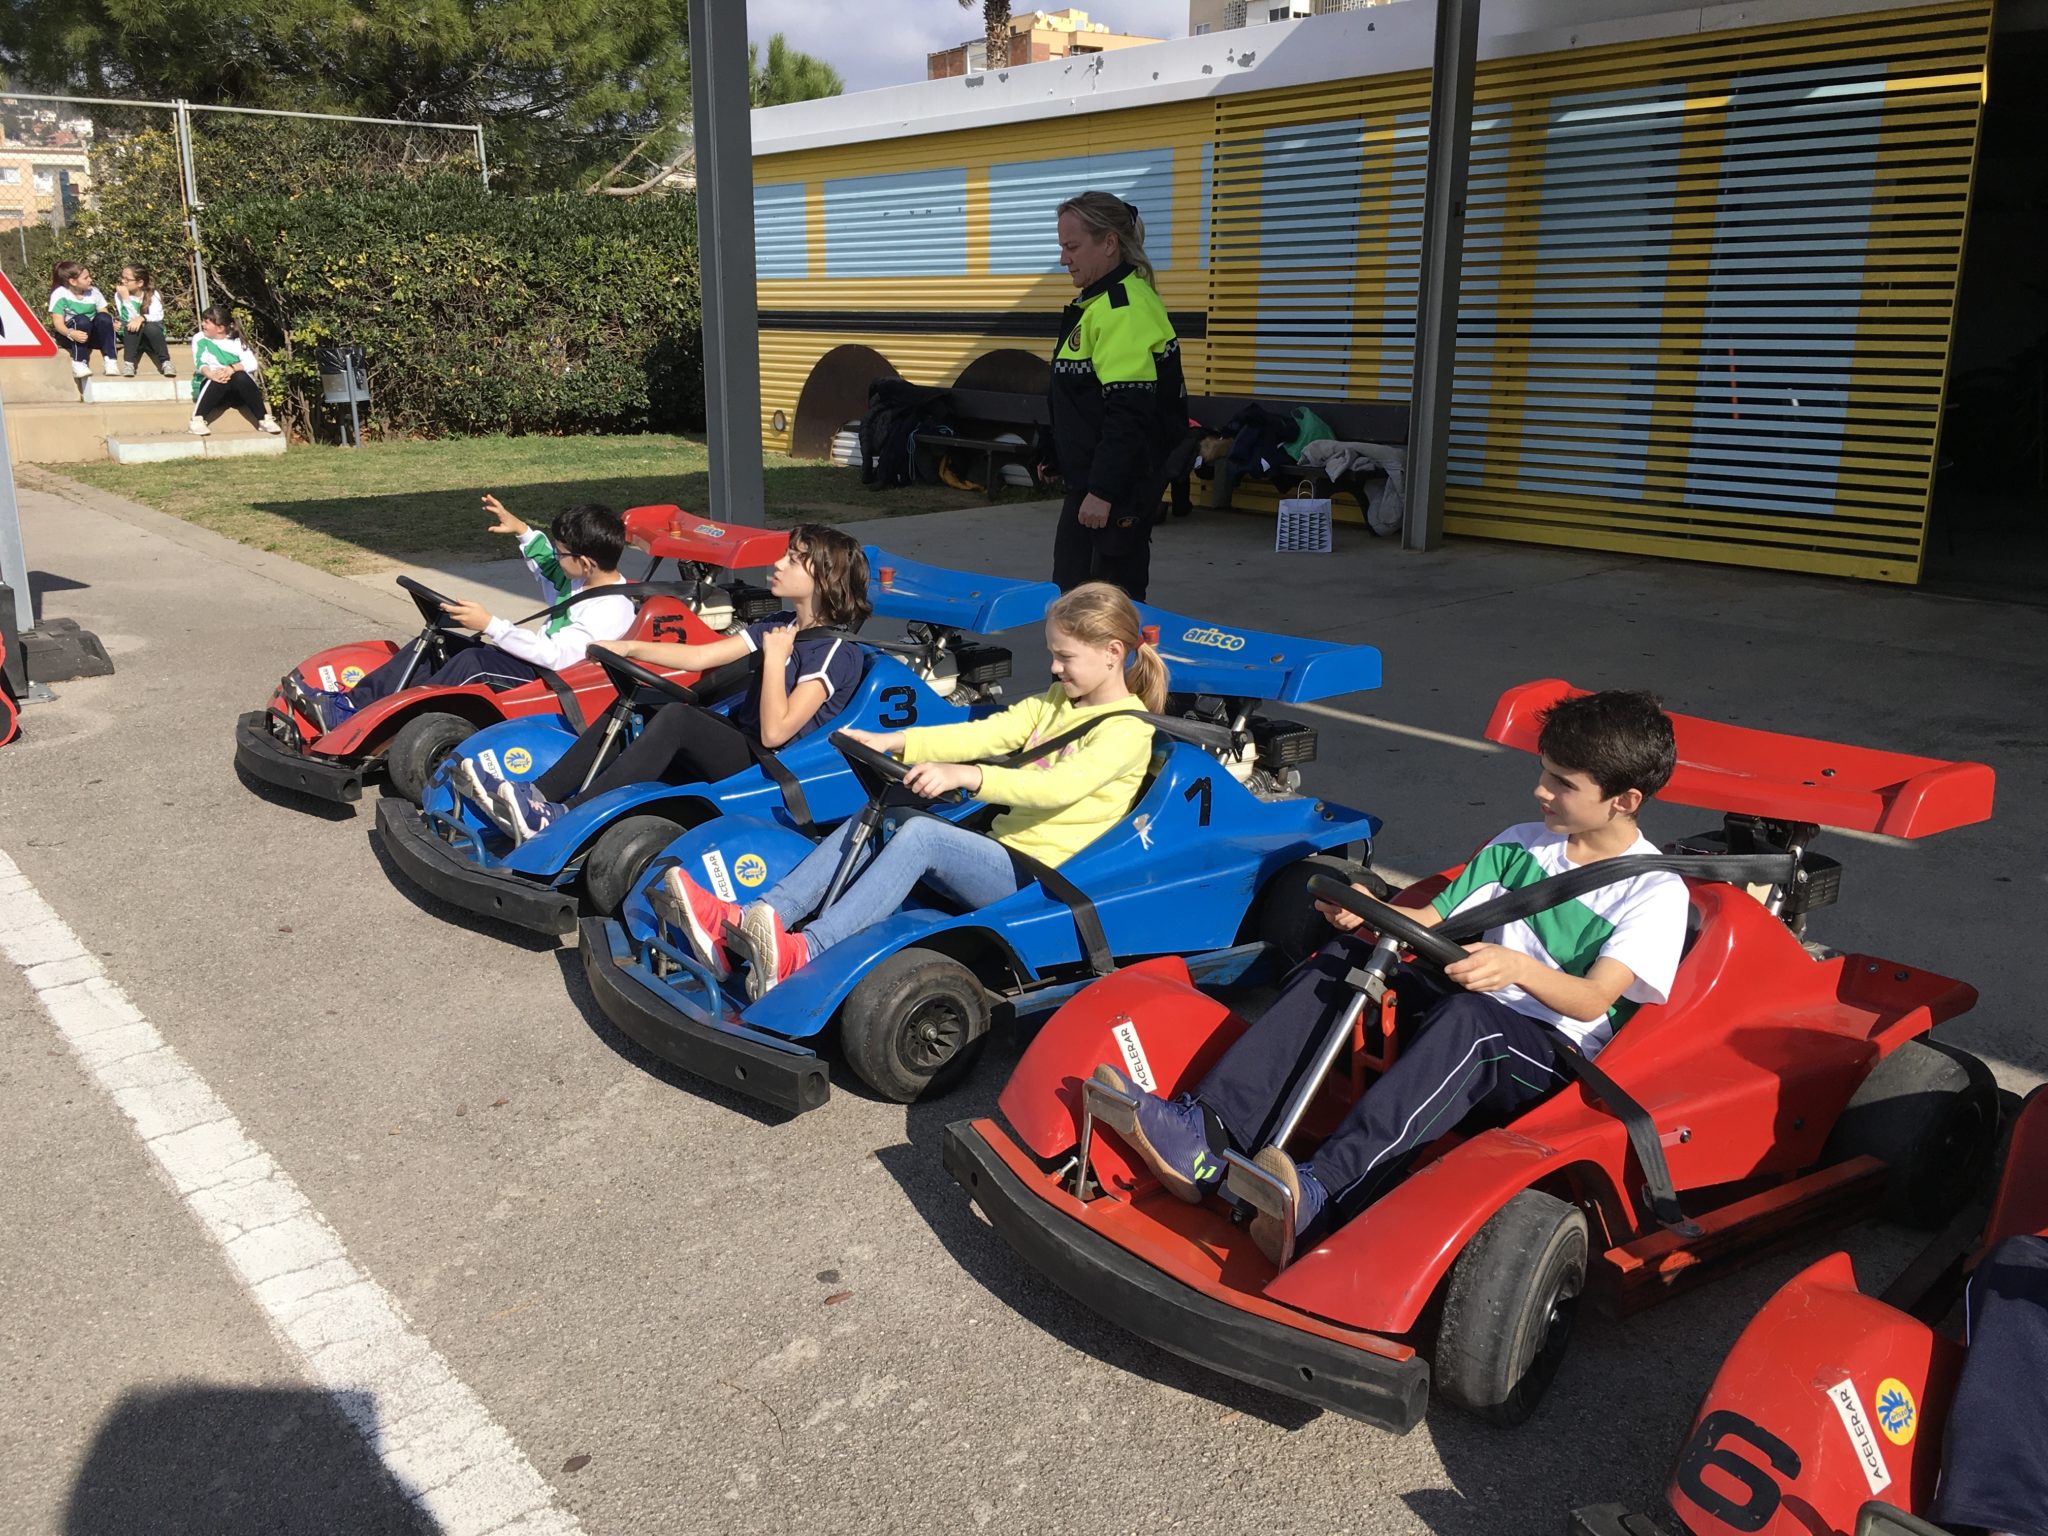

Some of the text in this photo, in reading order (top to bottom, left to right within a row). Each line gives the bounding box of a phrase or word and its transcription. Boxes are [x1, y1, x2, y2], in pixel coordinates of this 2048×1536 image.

[652, 614, 687, 644] 5
[1183, 628, 1245, 651] arisco
[879, 686, 918, 728] 3
[1184, 776, 1211, 827] 1
[709, 855, 730, 898] ACELERAR
[1121, 1028, 1149, 1086] ACELERAR
[1840, 1388, 1882, 1479] ACELERAR
[1676, 1410, 1801, 1532] 6
